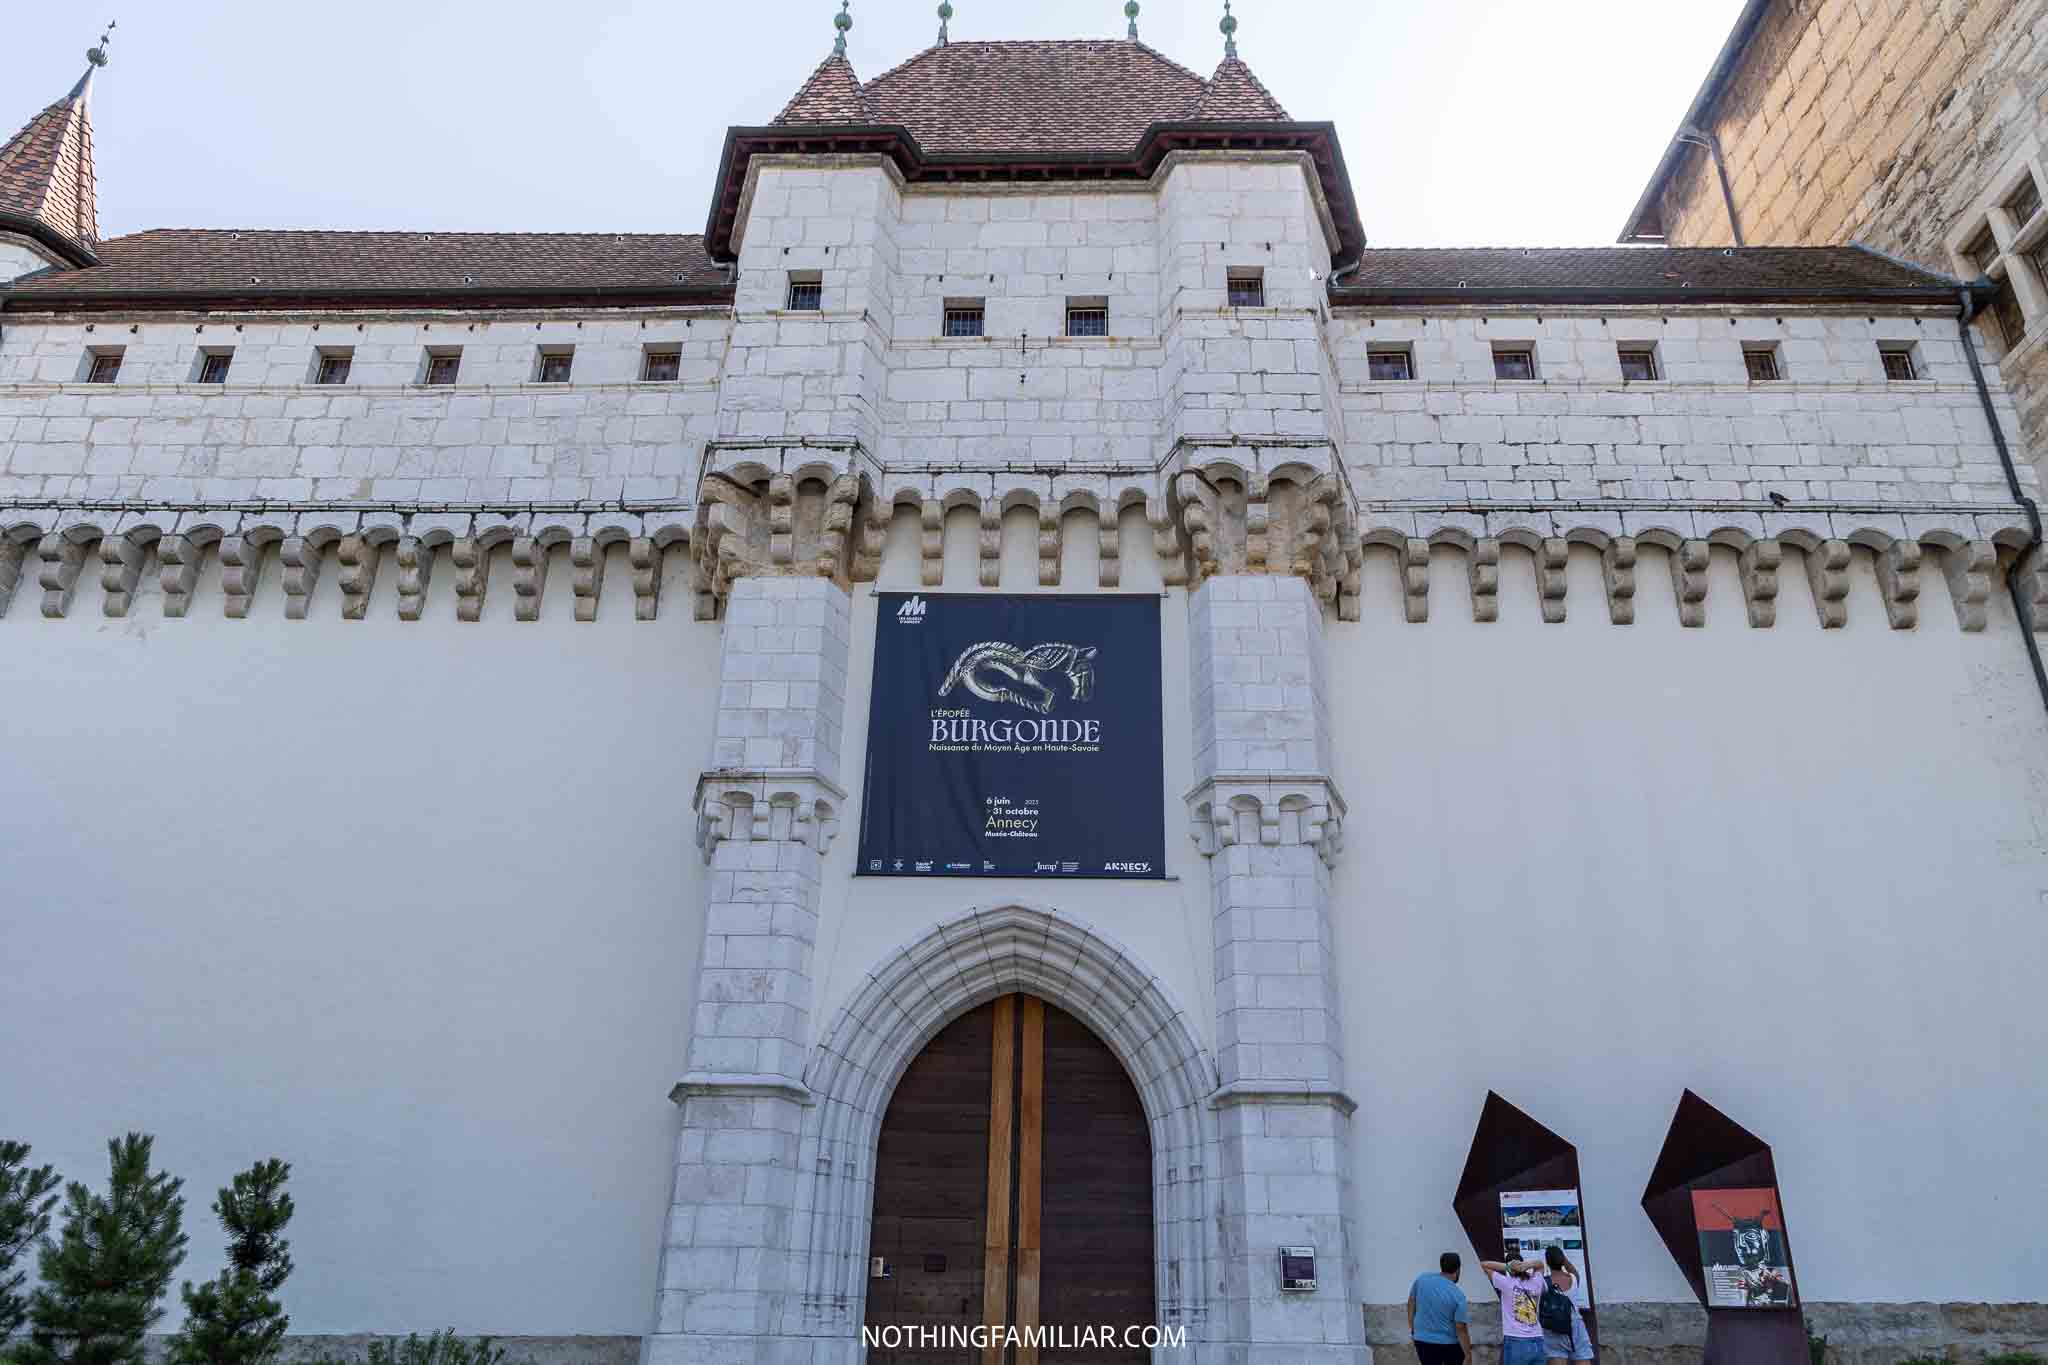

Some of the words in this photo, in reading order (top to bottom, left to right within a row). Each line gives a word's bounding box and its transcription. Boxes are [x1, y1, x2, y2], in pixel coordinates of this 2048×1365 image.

[931, 708, 970, 718] L'ÉPOPÉE
[928, 719, 1101, 742] BURGONDE
[928, 743, 970, 752] Naissance
[971, 743, 981, 752] du
[983, 743, 1012, 753] Moyen
[1013, 742, 1031, 754] Âge
[1032, 744, 1042, 752] en
[1044, 743, 1101, 752] Haute-Savoie
[994, 797, 1010, 806] juin
[985, 815, 1038, 832] Annecy
